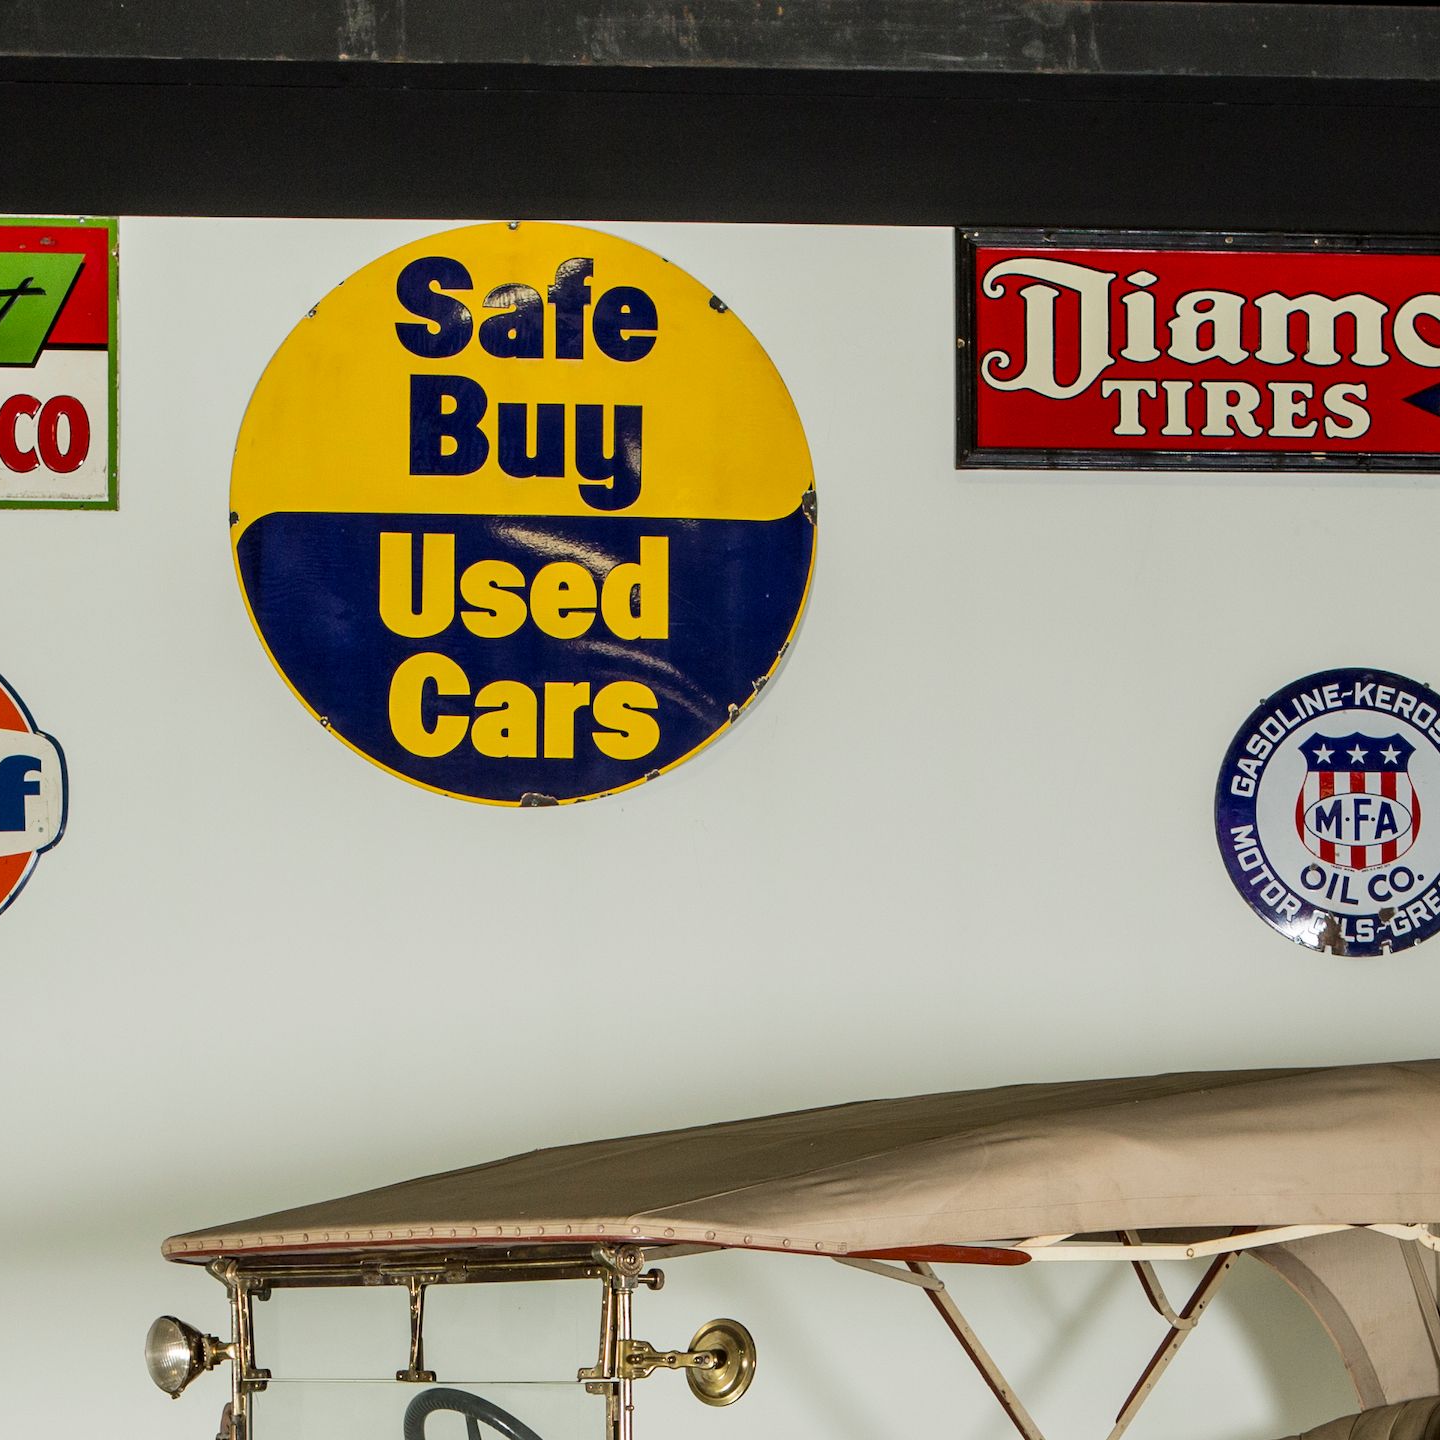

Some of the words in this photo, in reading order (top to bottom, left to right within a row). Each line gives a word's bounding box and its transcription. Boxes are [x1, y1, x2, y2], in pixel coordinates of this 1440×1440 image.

[394, 256, 659, 362] Safe
[408, 373, 643, 511] Buy
[1101, 379, 1371, 438] TIRES
[378, 532, 669, 640] Used
[387, 651, 660, 760] Cars
[1230, 824, 1303, 922] MOTOR
[1300, 865, 1359, 906] OIL
[1367, 866, 1425, 902] CO.
